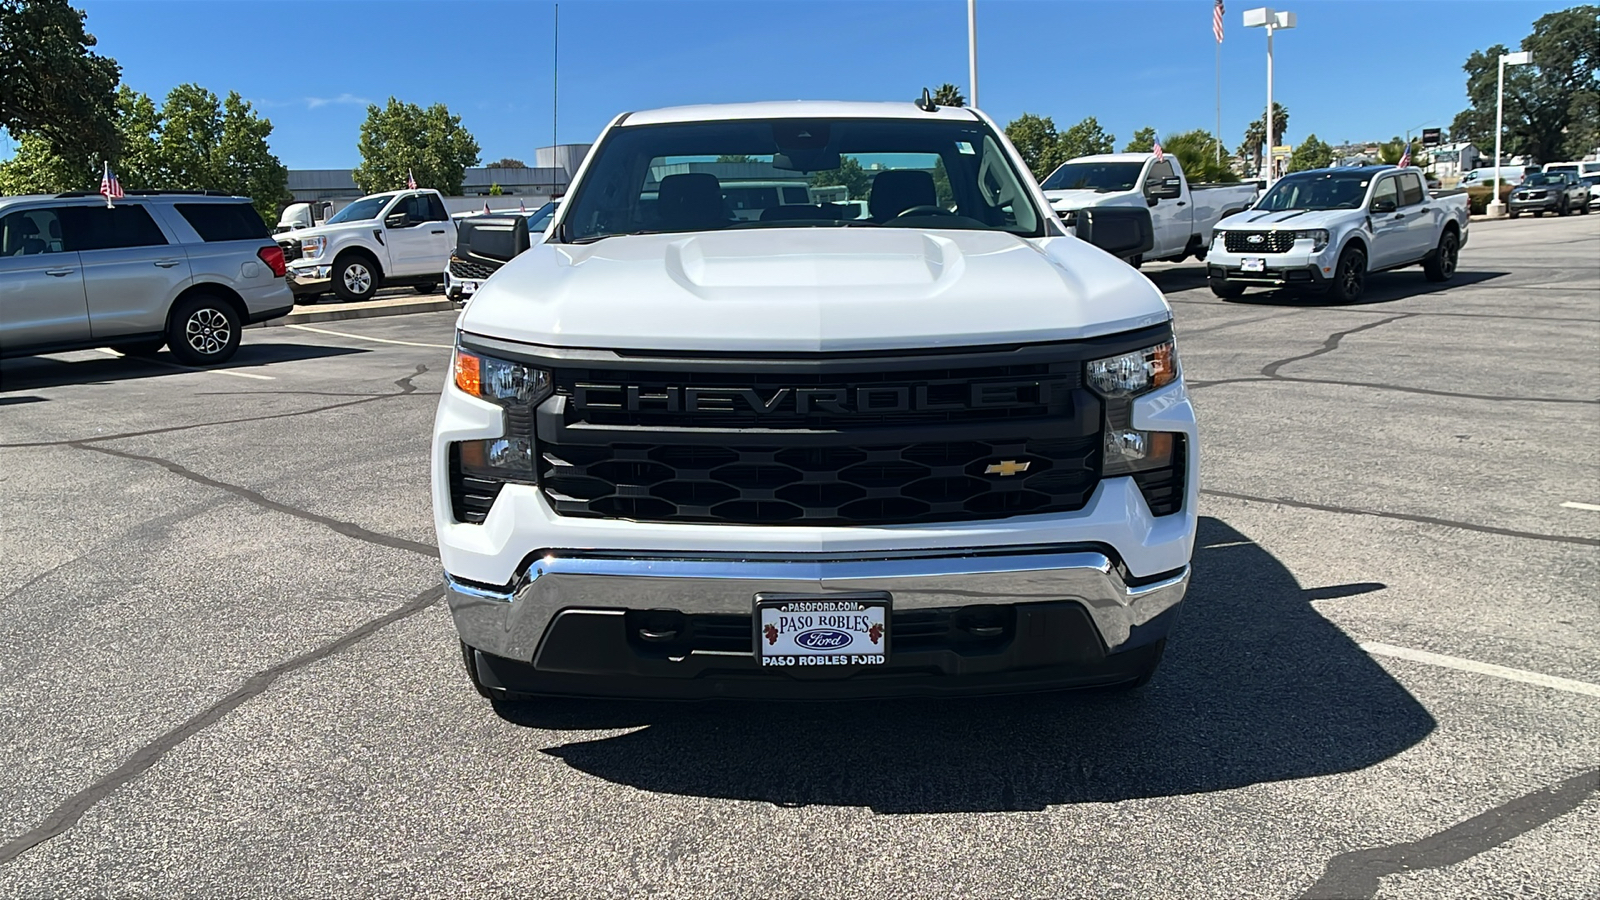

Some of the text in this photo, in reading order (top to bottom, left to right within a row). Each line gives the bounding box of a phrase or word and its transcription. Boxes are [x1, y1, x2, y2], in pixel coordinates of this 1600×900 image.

[573, 376, 1067, 414] CHEVROLET
[788, 602, 859, 612] PASOFORD.COM
[779, 615, 870, 634] PASO ROBLES
[806, 632, 842, 646] Ford
[762, 656, 795, 667] PASO
[799, 655, 848, 666] ROBLES
